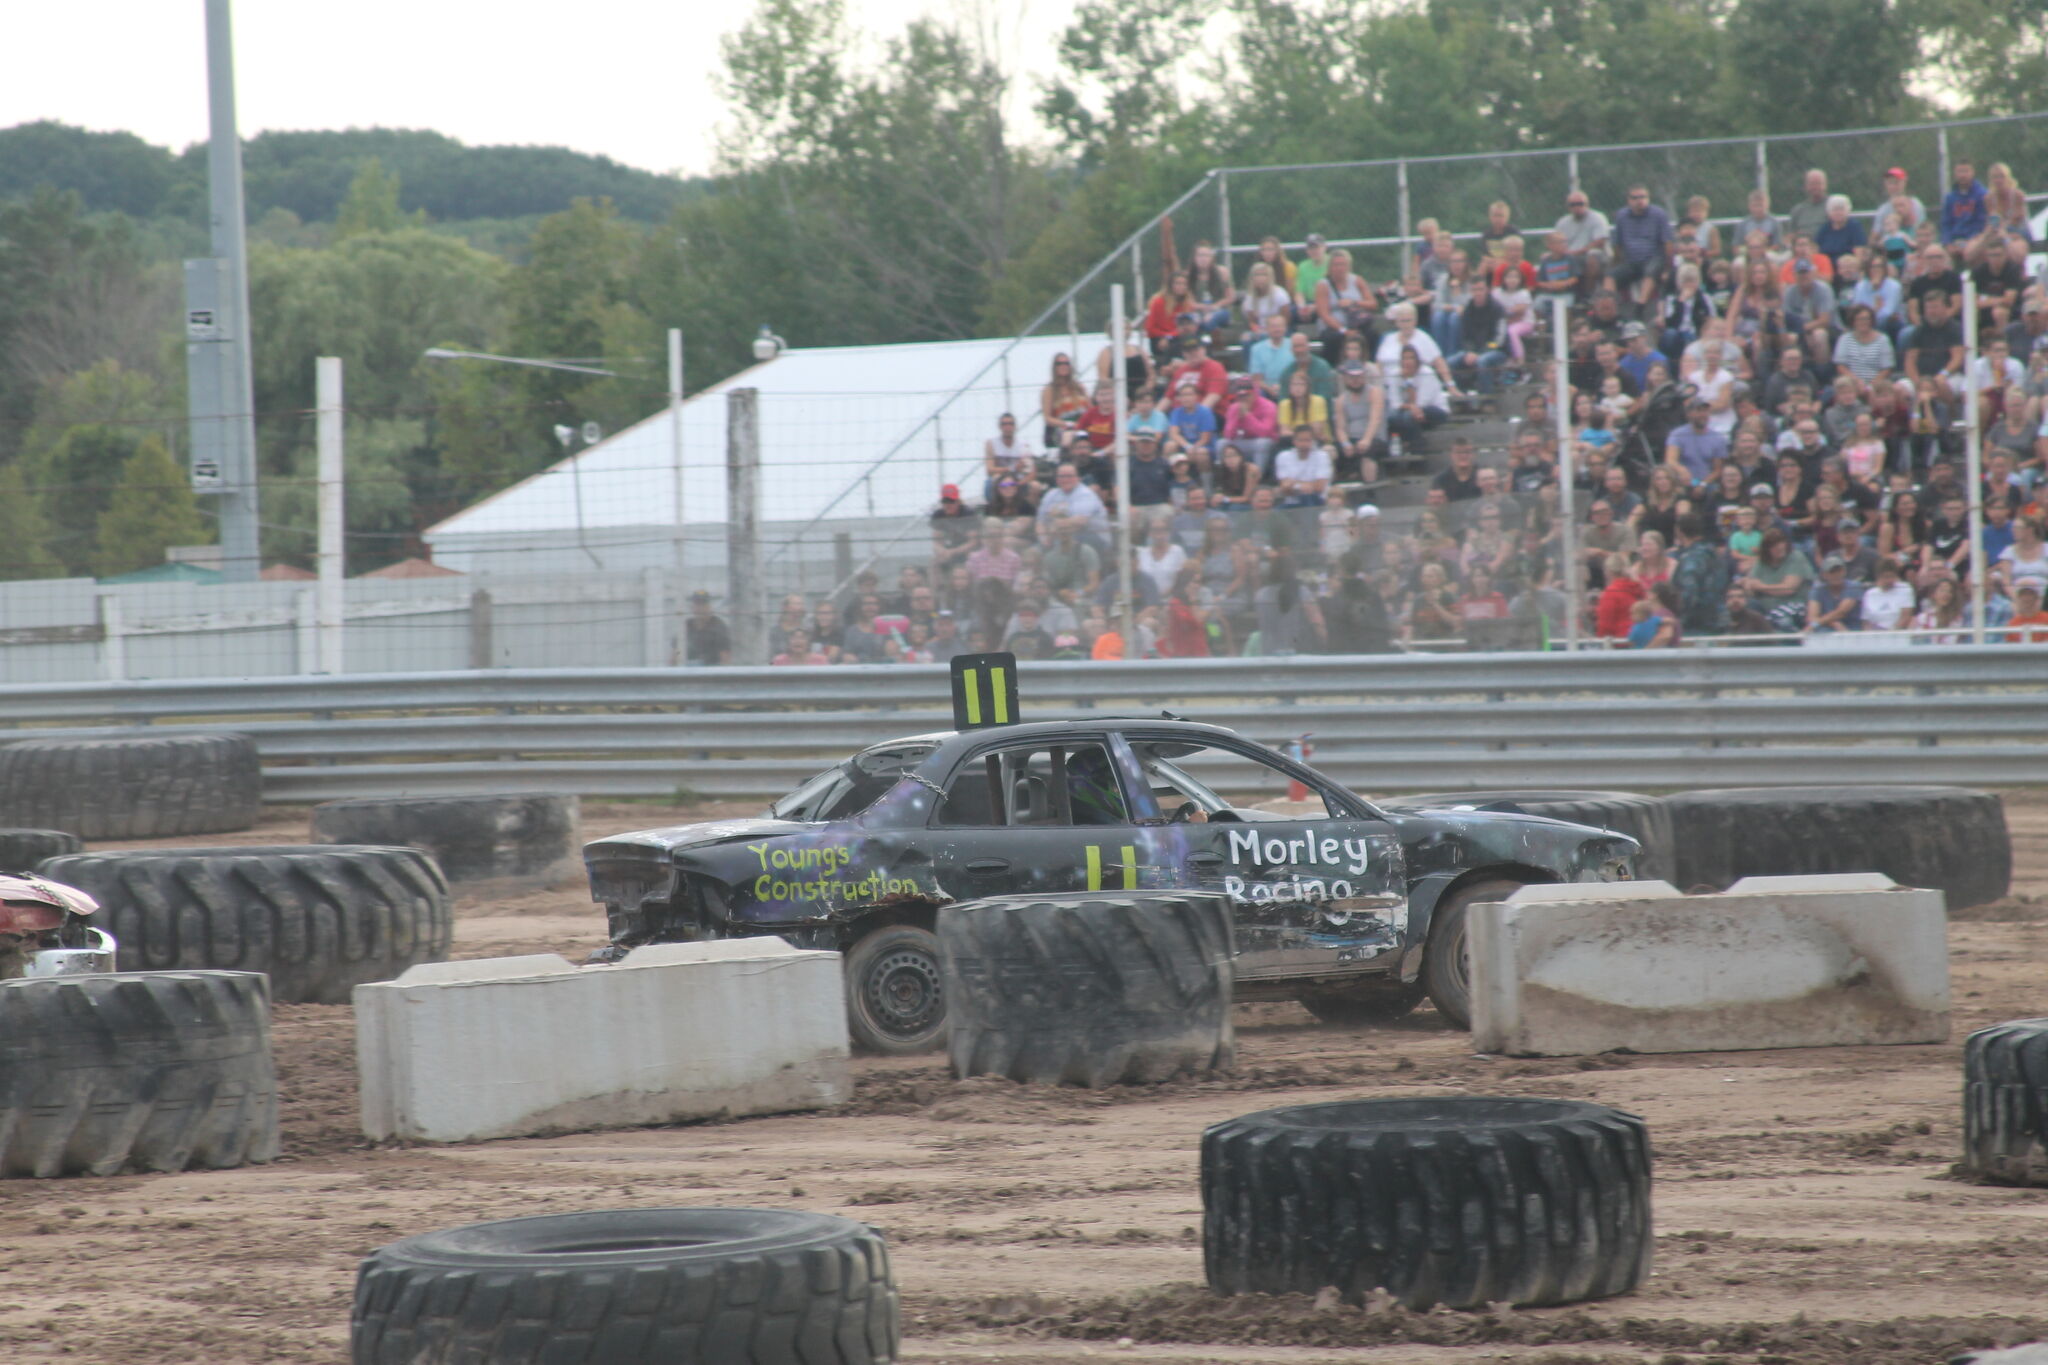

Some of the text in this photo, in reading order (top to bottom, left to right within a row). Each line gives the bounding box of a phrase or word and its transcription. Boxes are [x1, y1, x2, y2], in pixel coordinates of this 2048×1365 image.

[963, 667, 1008, 724] 11
[748, 843, 850, 876] Young's
[1085, 845, 1137, 891] 11
[1229, 829, 1368, 875] Morley
[754, 870, 918, 901] Construction
